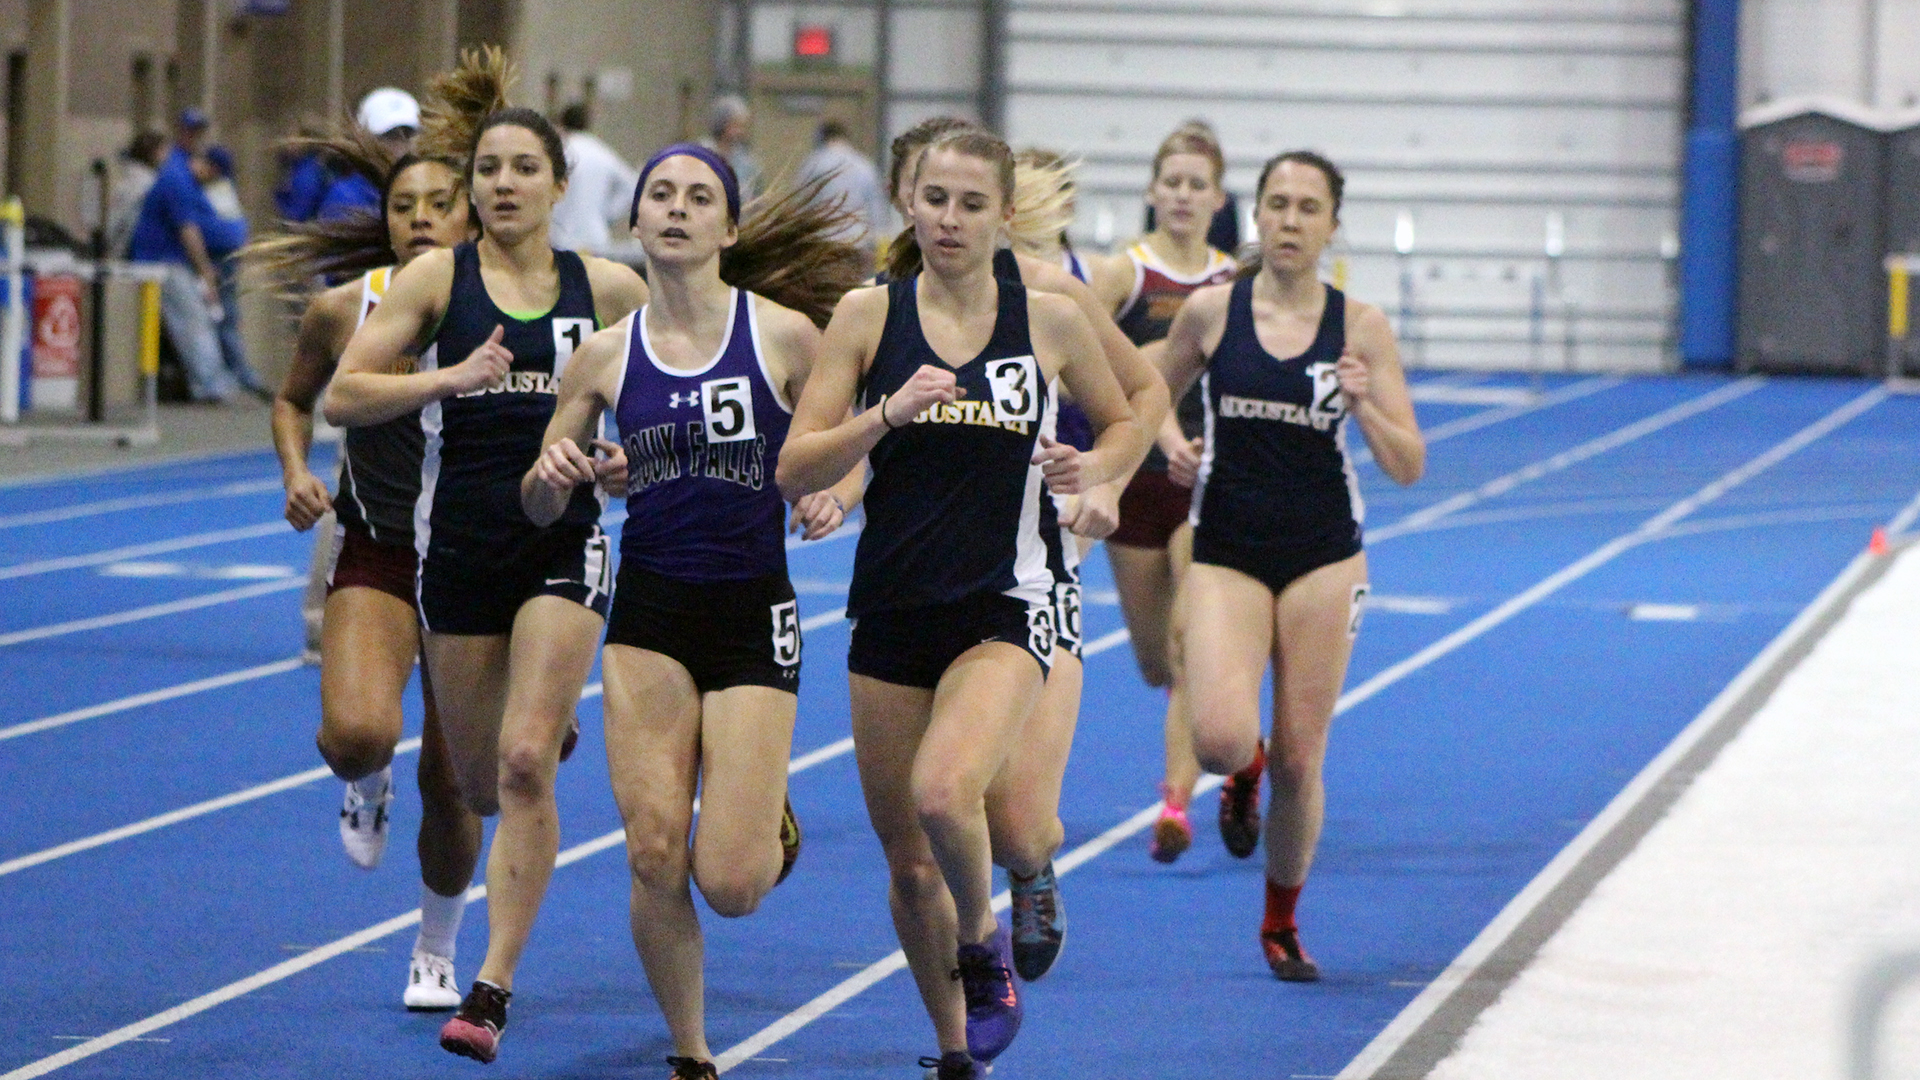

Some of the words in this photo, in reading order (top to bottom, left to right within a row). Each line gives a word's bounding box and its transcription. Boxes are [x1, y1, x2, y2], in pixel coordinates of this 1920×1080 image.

[562, 324, 581, 352] 1
[710, 383, 745, 437] 5
[995, 362, 1031, 416] 3
[1320, 370, 1340, 413] 2
[687, 421, 767, 491] FALLS
[778, 607, 798, 661] 5
[1033, 610, 1053, 657] 3
[1063, 587, 1080, 639] 6
